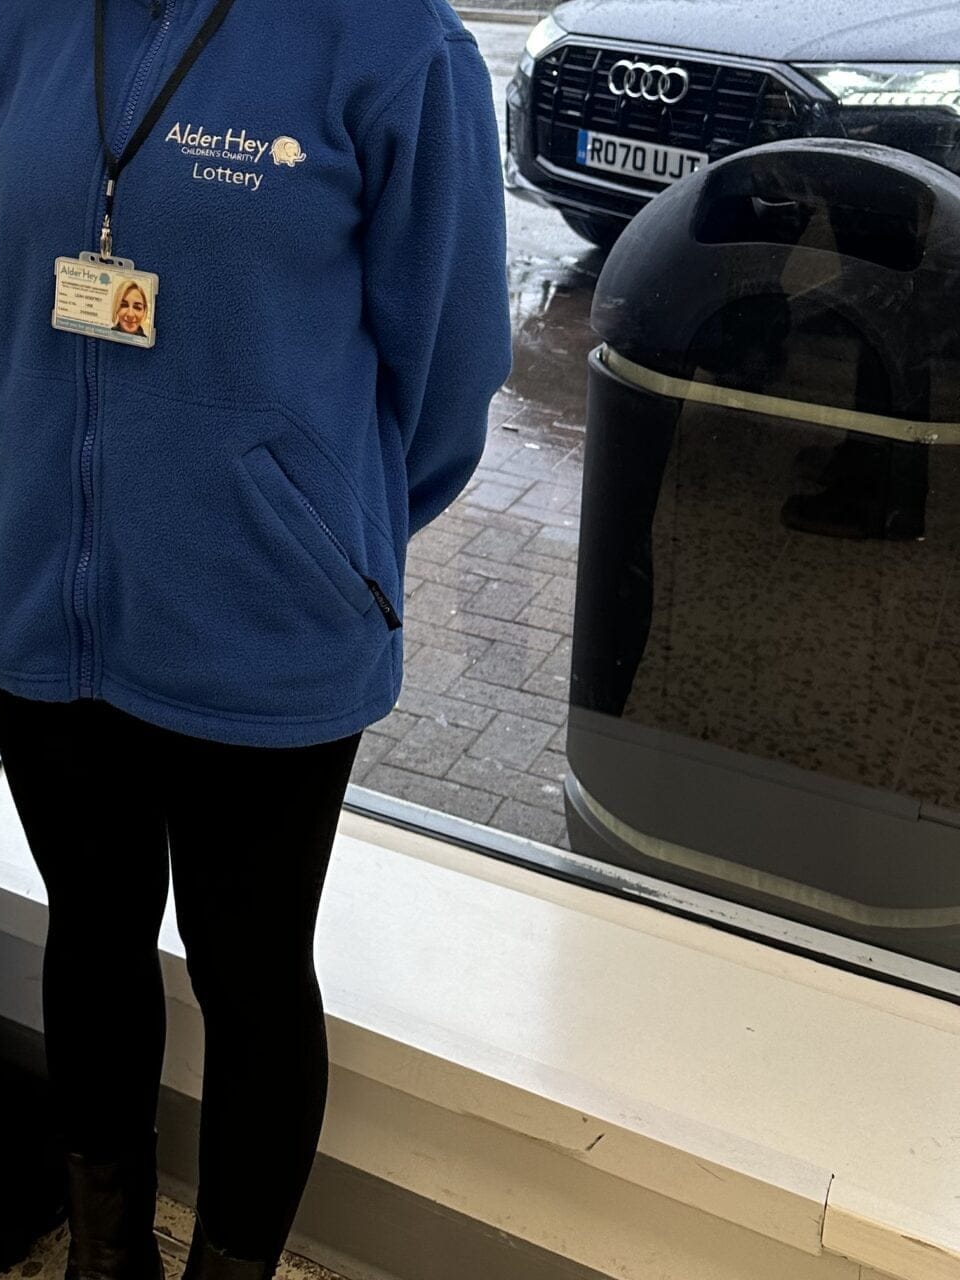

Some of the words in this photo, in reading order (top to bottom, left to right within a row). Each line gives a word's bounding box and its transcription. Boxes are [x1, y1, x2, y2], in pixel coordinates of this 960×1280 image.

[165, 121, 222, 149] Alder
[224, 128, 270, 163] Hey
[222, 150, 255, 162] CHARITY
[590, 138, 646, 171] RO70
[653, 149, 701, 179] UJT
[192, 162, 264, 192] Lottery
[60, 265, 82, 278] Alder
[82, 268, 98, 283] Hey
